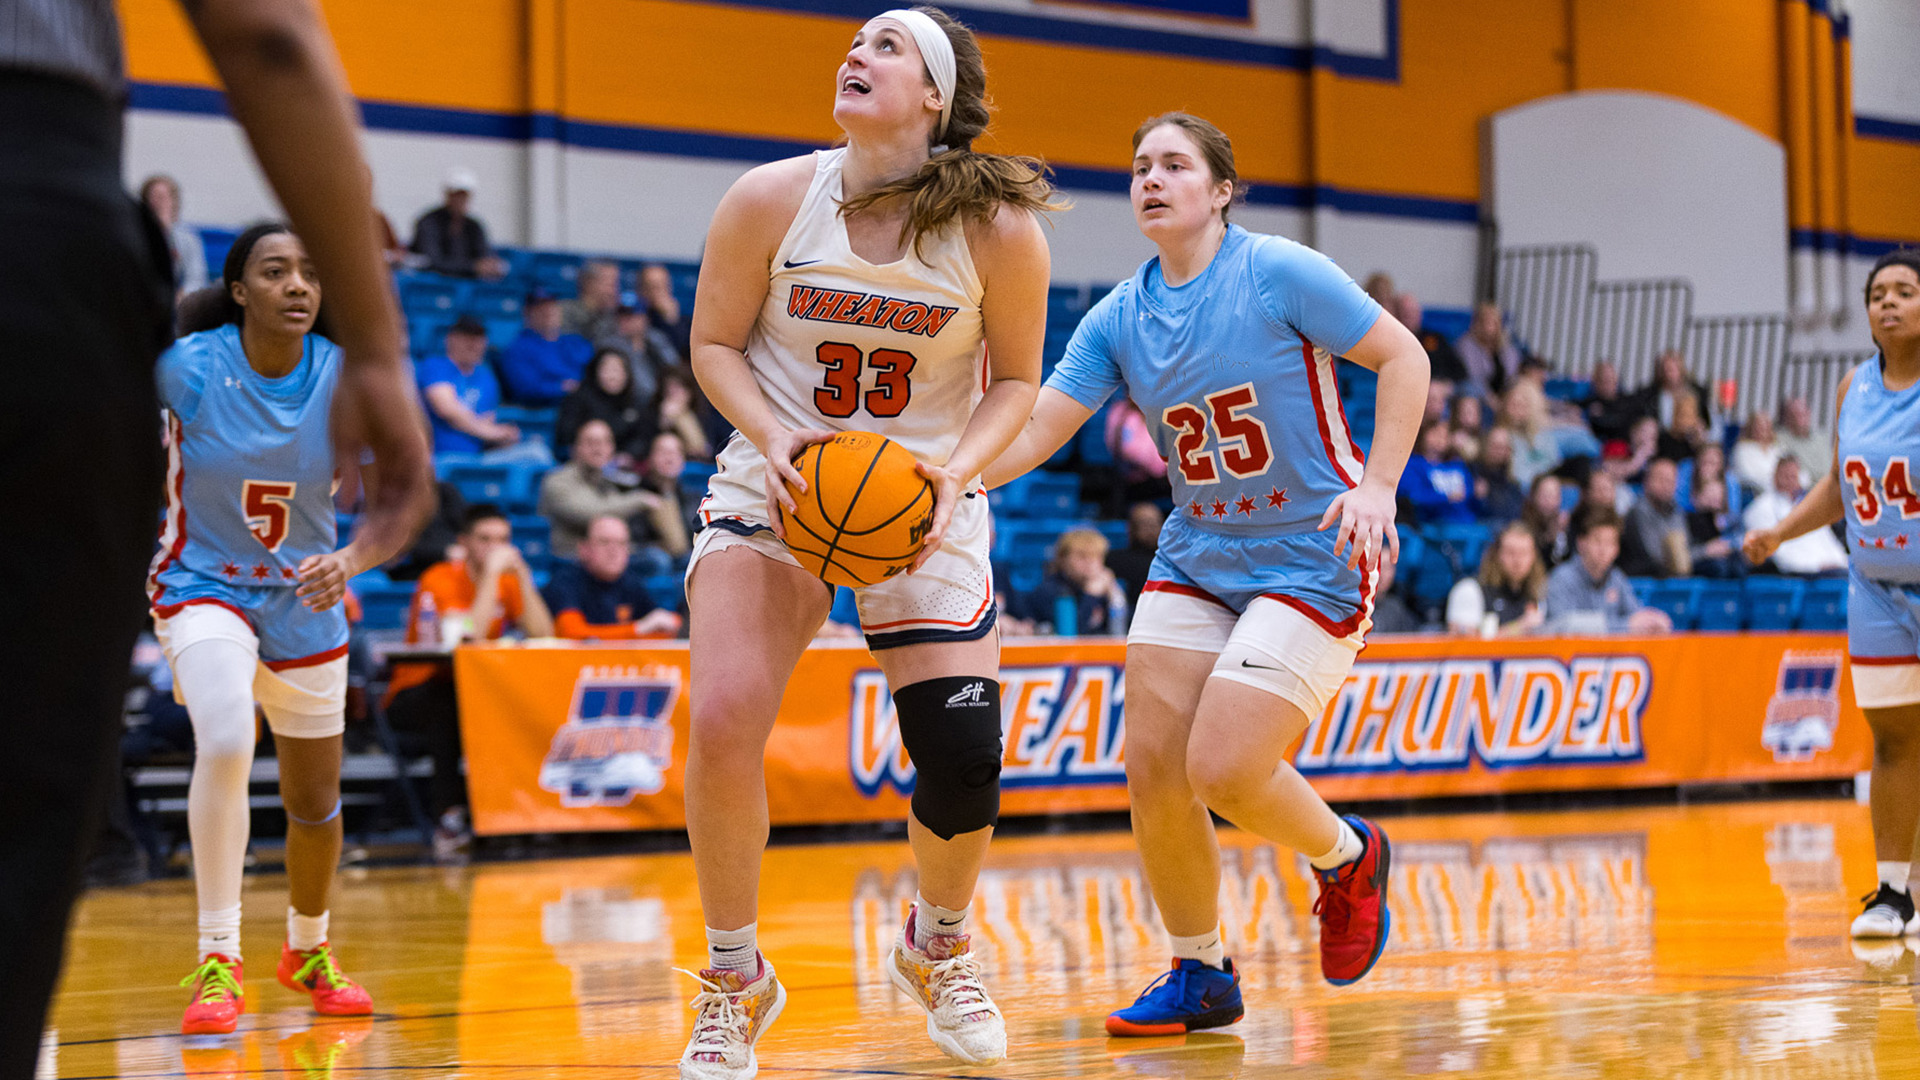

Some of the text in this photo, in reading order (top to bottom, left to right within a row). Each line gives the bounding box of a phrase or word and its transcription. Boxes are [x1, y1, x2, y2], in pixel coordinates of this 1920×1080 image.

[787, 284, 960, 338] WHEATON
[814, 341, 917, 418] 33
[1162, 381, 1275, 486] 25
[241, 479, 297, 554] 5
[1843, 455, 1920, 527] 34
[1295, 653, 1653, 776] THUNDER
